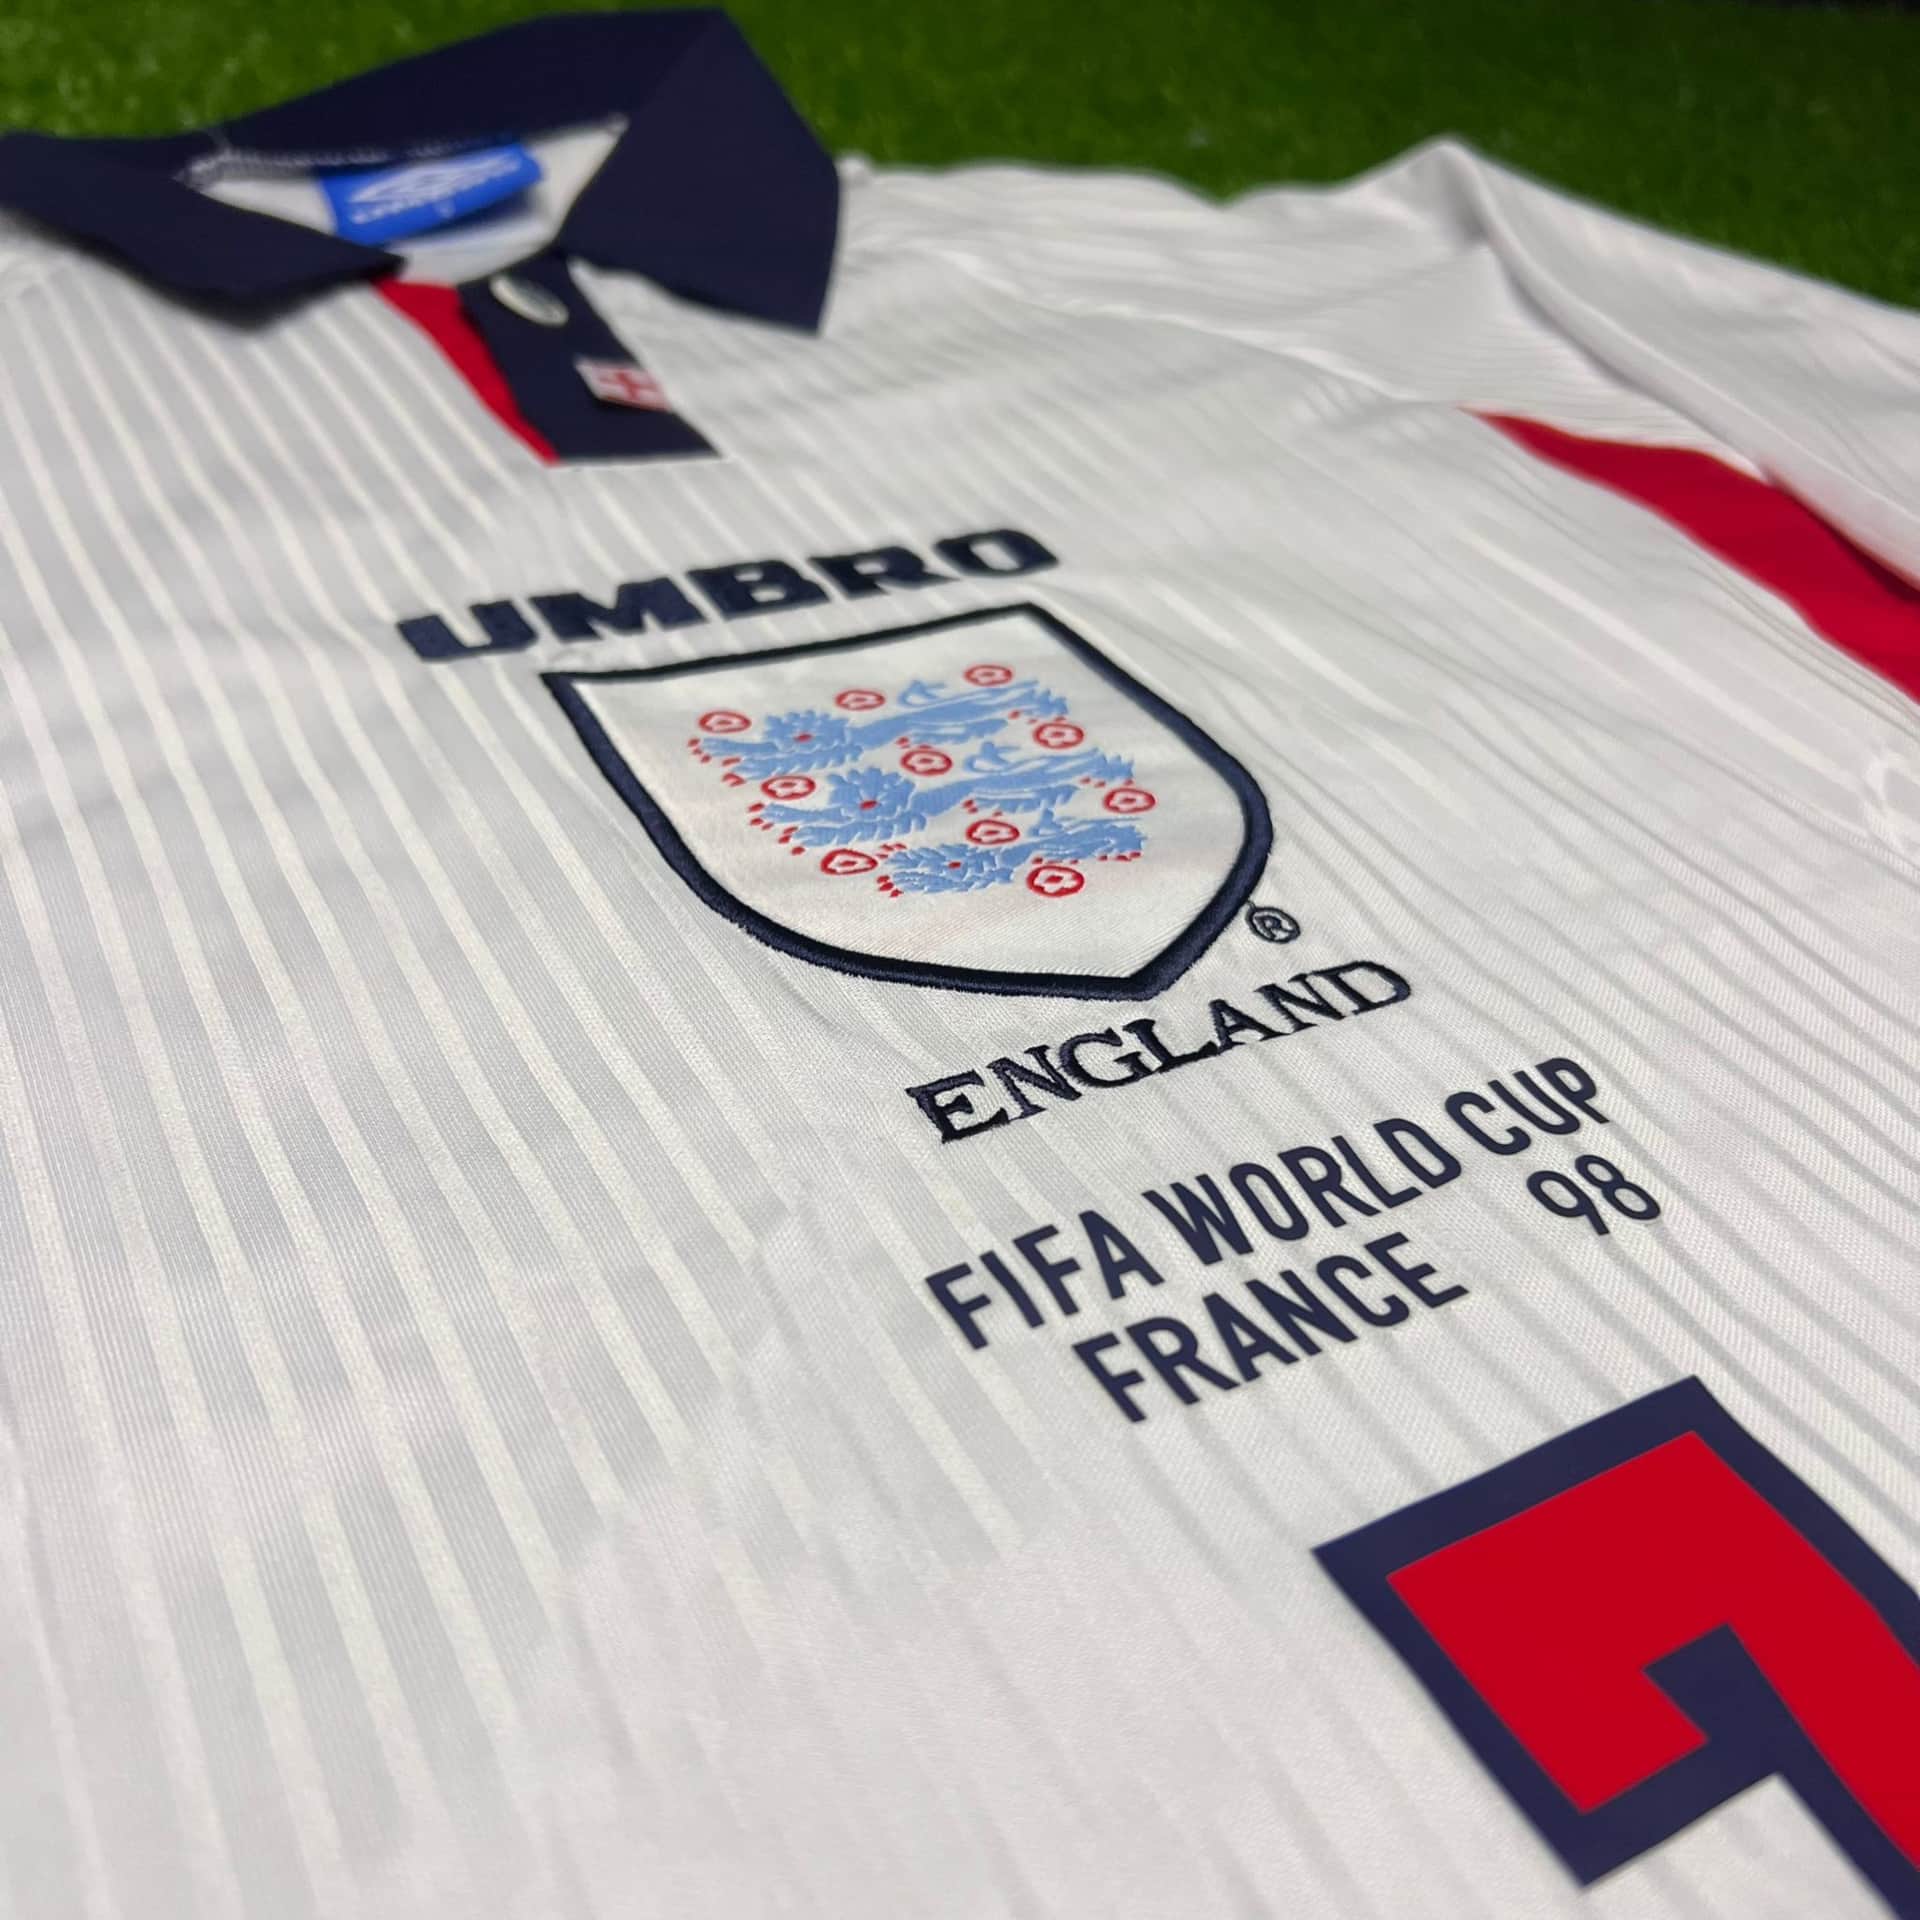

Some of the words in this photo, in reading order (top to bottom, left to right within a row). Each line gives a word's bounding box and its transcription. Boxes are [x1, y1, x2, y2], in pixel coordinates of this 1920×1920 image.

[396, 528, 1059, 662] UMBRO
[904, 959, 1412, 1145] ENGLAND
[925, 1210, 1165, 1350] FIFA
[1141, 1117, 1462, 1266] WORLD
[1444, 1057, 1610, 1156] CUP
[1071, 1231, 1469, 1423] FRANCE
[1526, 1154, 1661, 1236] 98
